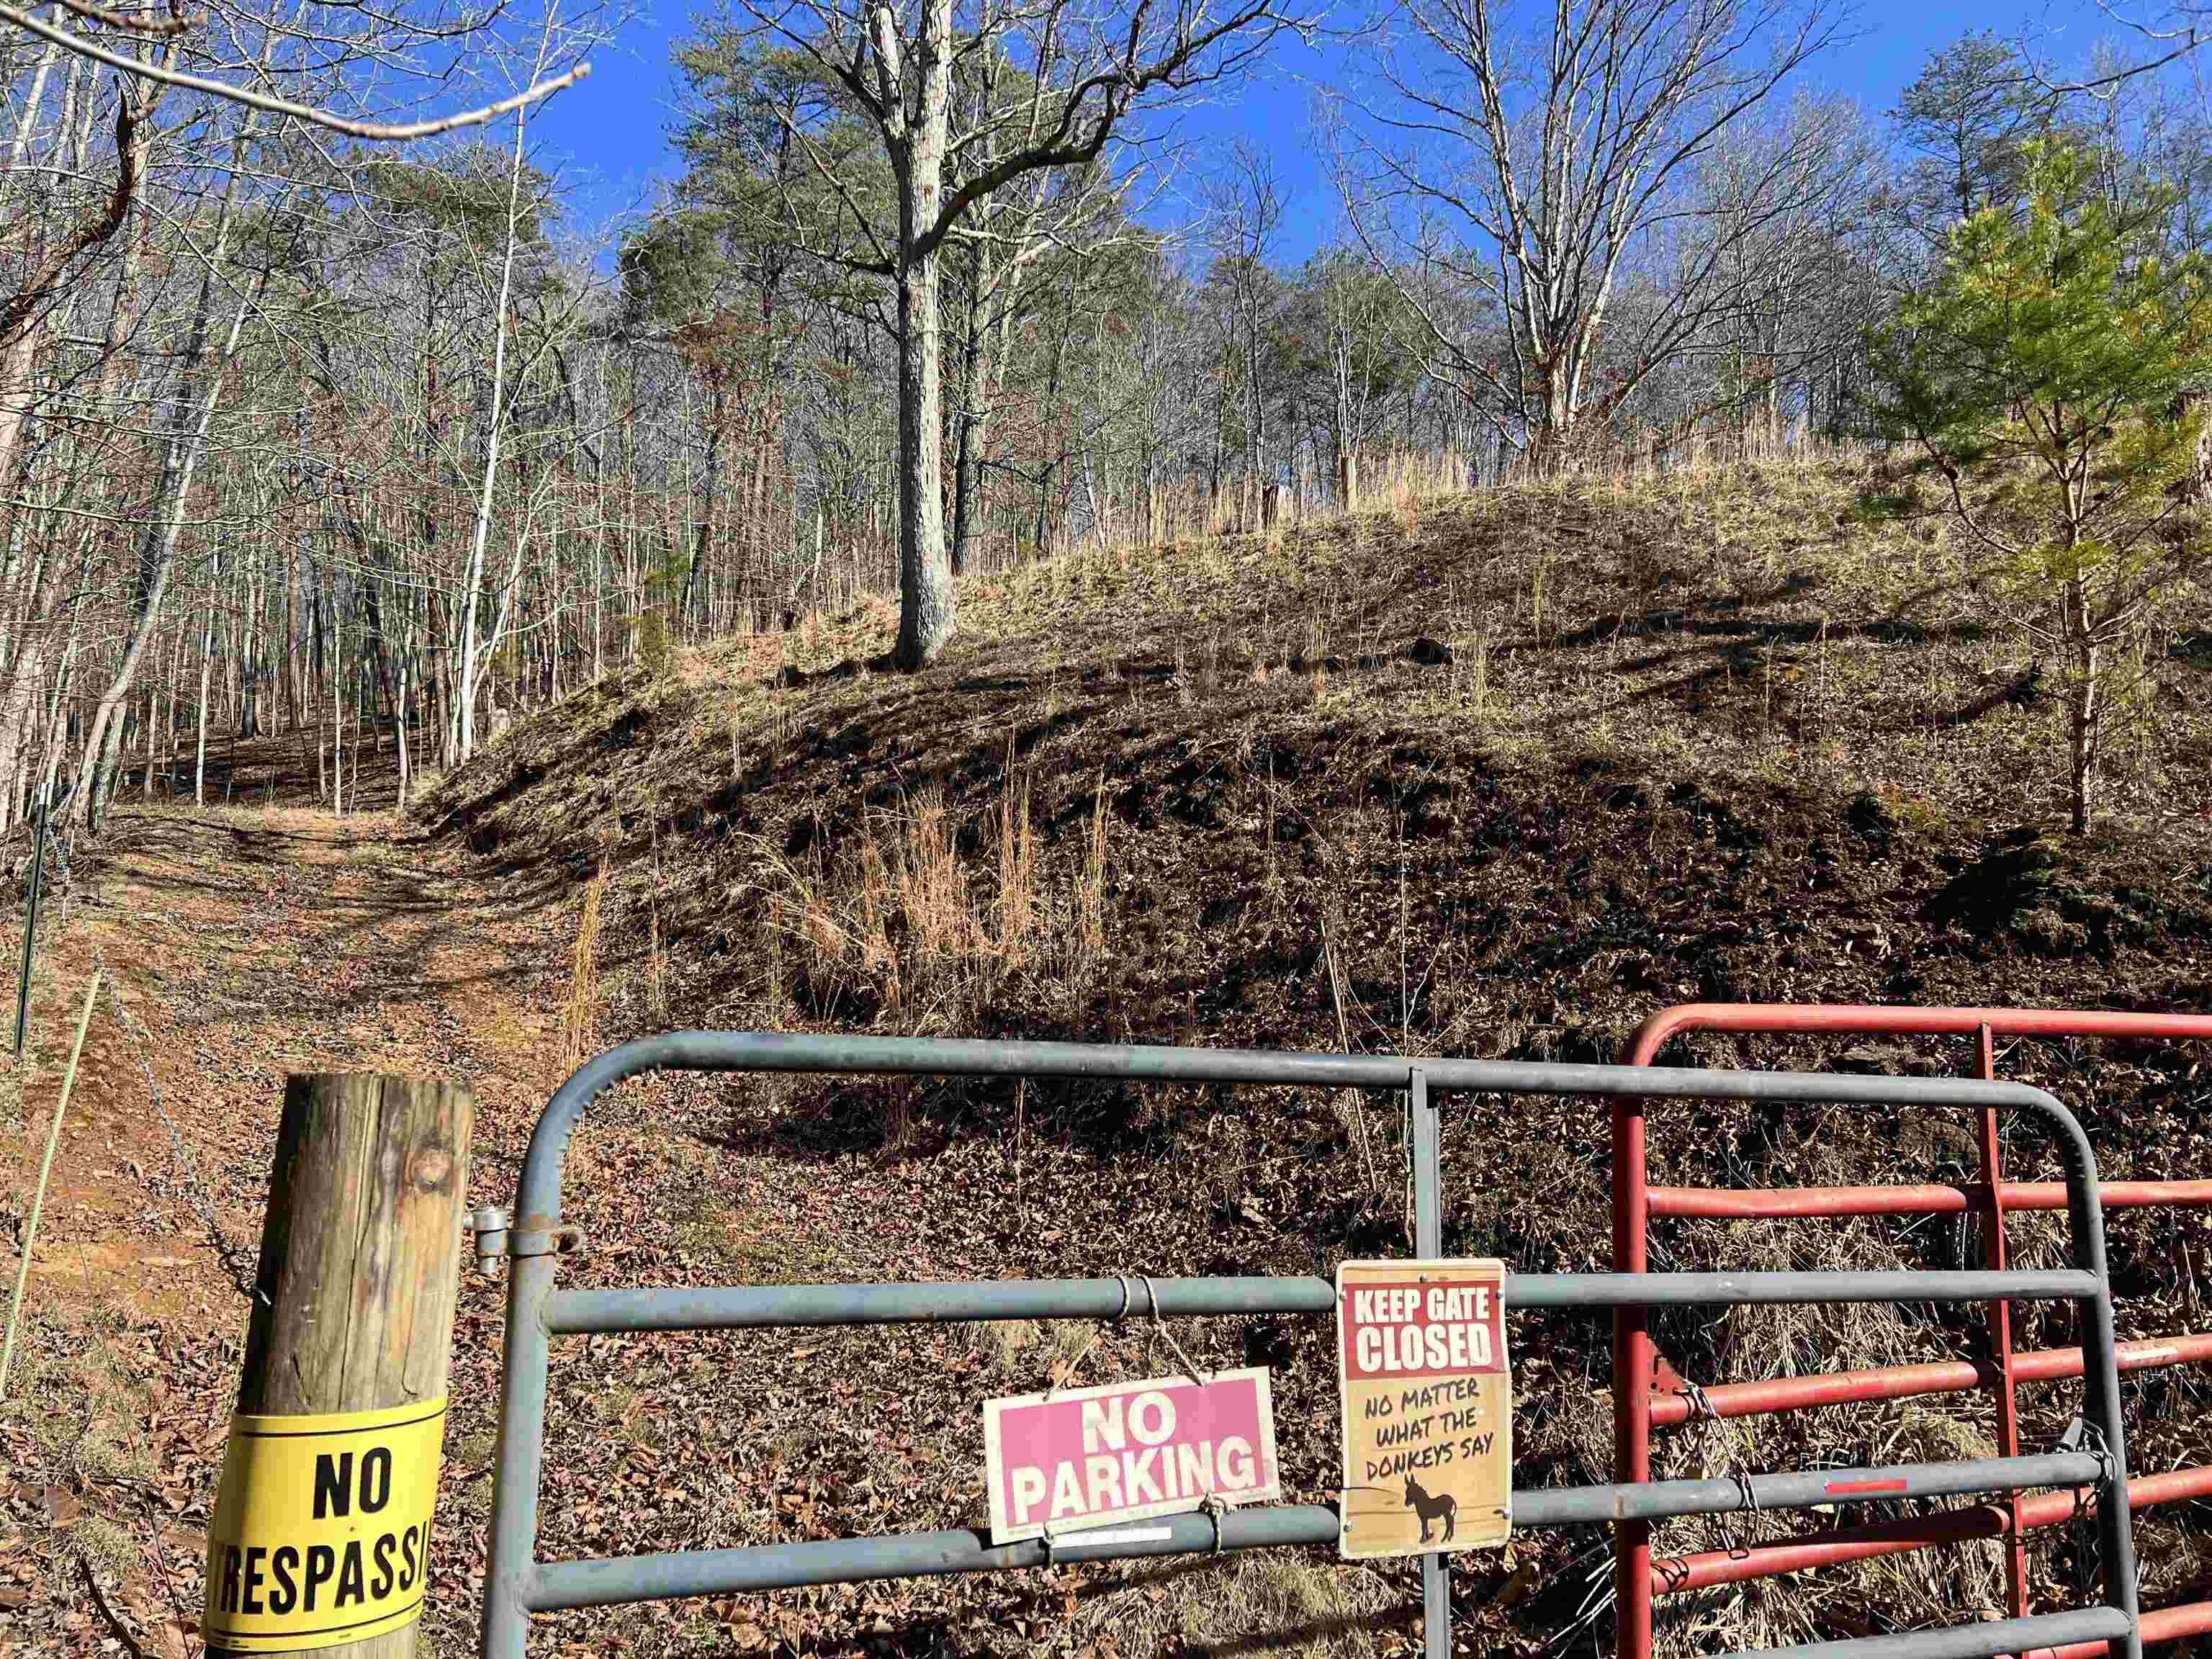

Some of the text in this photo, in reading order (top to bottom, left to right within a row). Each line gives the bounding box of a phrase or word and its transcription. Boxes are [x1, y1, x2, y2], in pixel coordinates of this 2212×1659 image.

[1354, 1287, 1490, 1323] KEEP GATE
[1357, 1323, 1493, 1372] CLOSED
[1082, 1390, 1176, 1452] NO
[1365, 1377, 1480, 1419] NO MATTER
[1376, 1406, 1477, 1447] WHAT THE
[1011, 1435, 1256, 1524] PARKING
[1366, 1432, 1495, 1480] DONKEYS SAY
[314, 1447, 391, 1519] NO
[214, 1521, 428, 1614] RESPASSI
